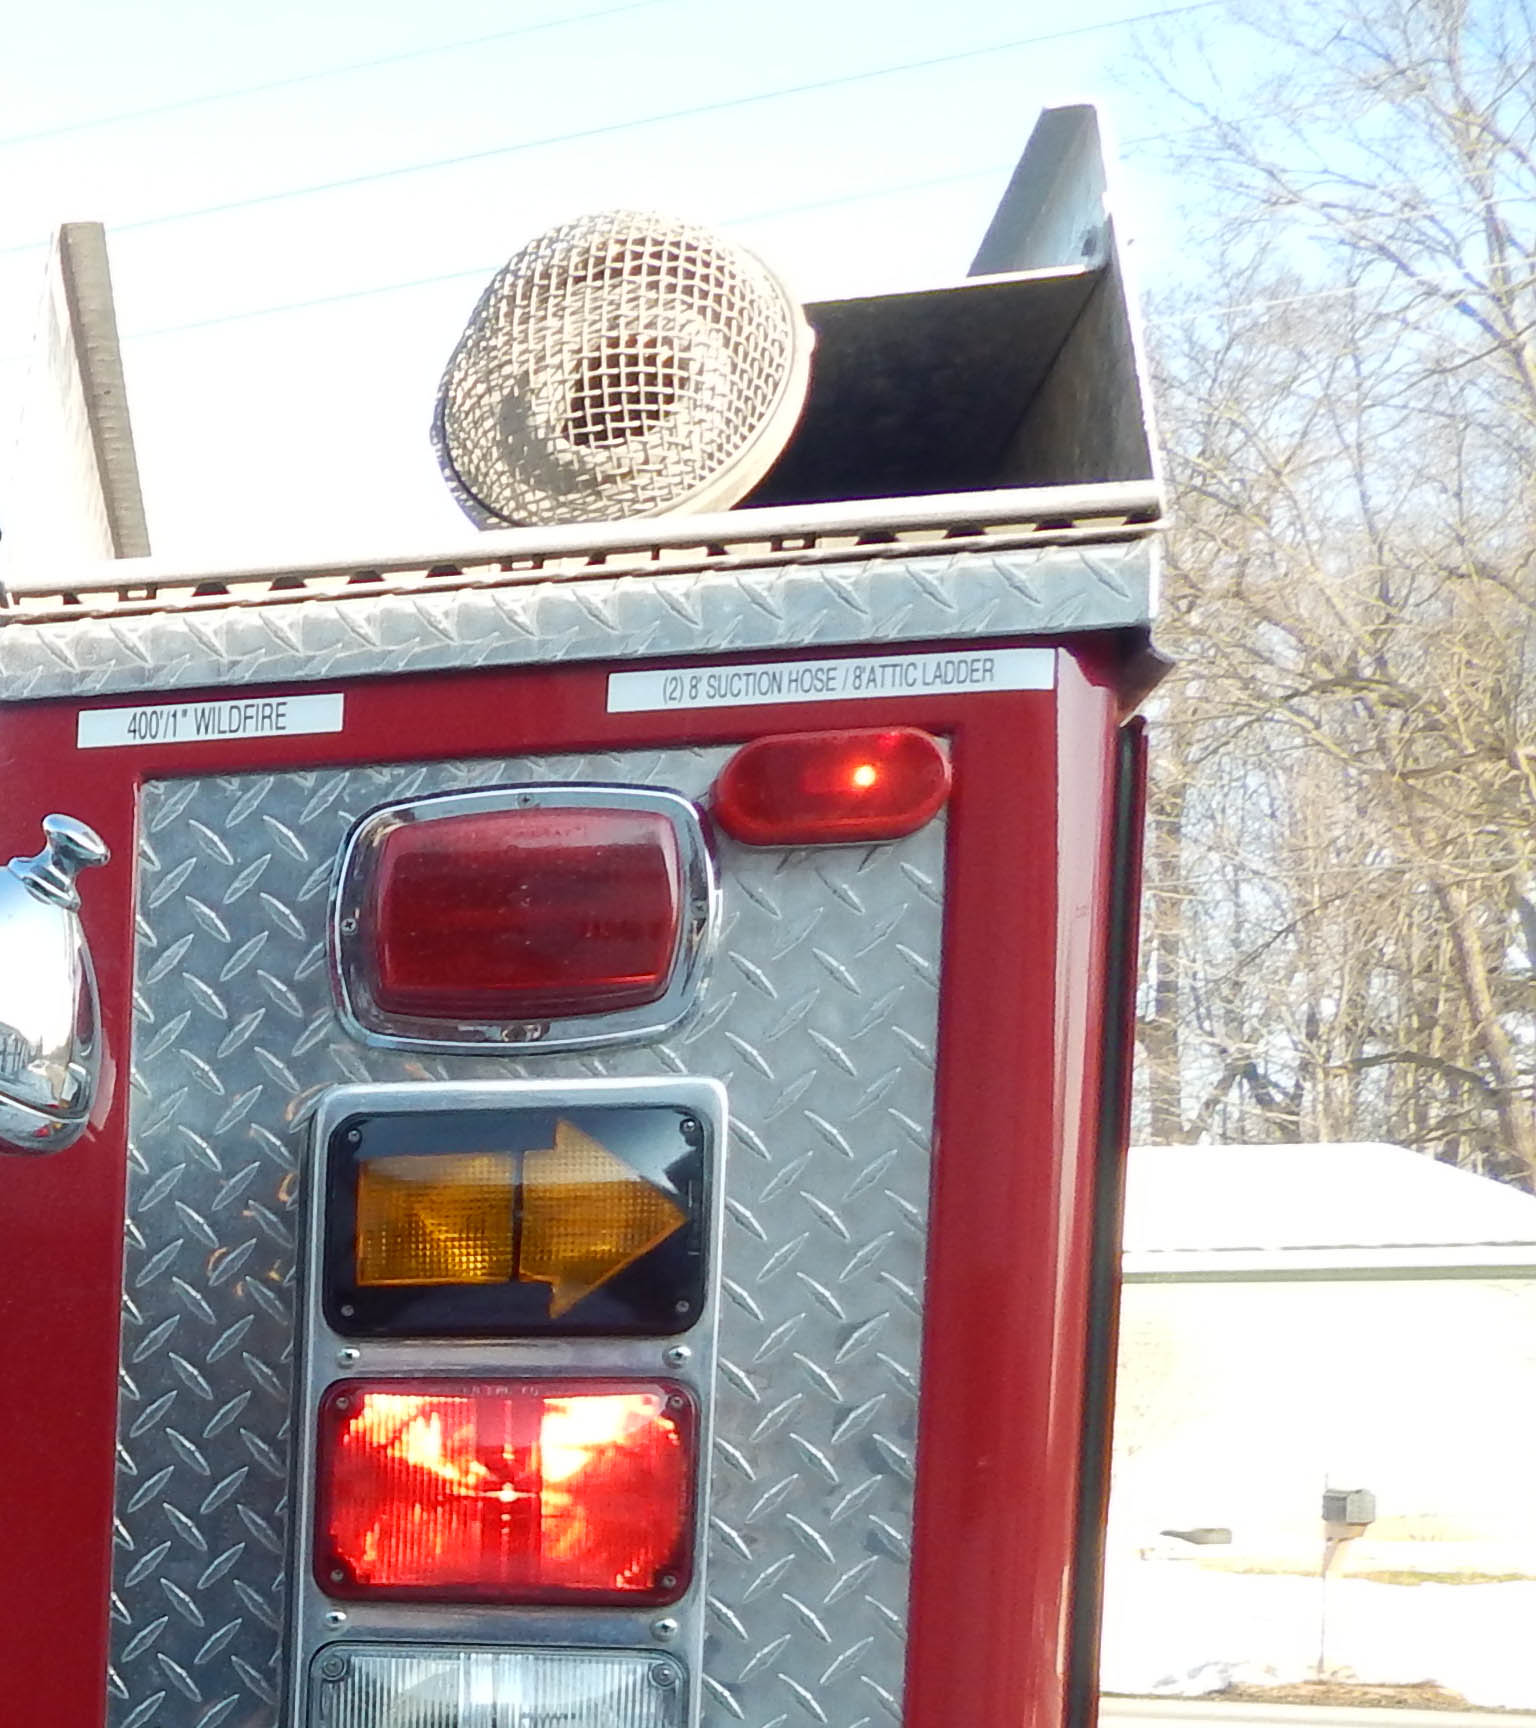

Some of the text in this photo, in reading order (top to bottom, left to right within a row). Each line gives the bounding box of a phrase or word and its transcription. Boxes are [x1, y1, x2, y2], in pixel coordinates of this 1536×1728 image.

[662, 675, 685, 704] (2)
[706, 667, 782, 700] SUCTION
[787, 667, 837, 694] HOSE
[921, 658, 996, 687] LADDER
[194, 701, 288, 737] WILDFIRE
